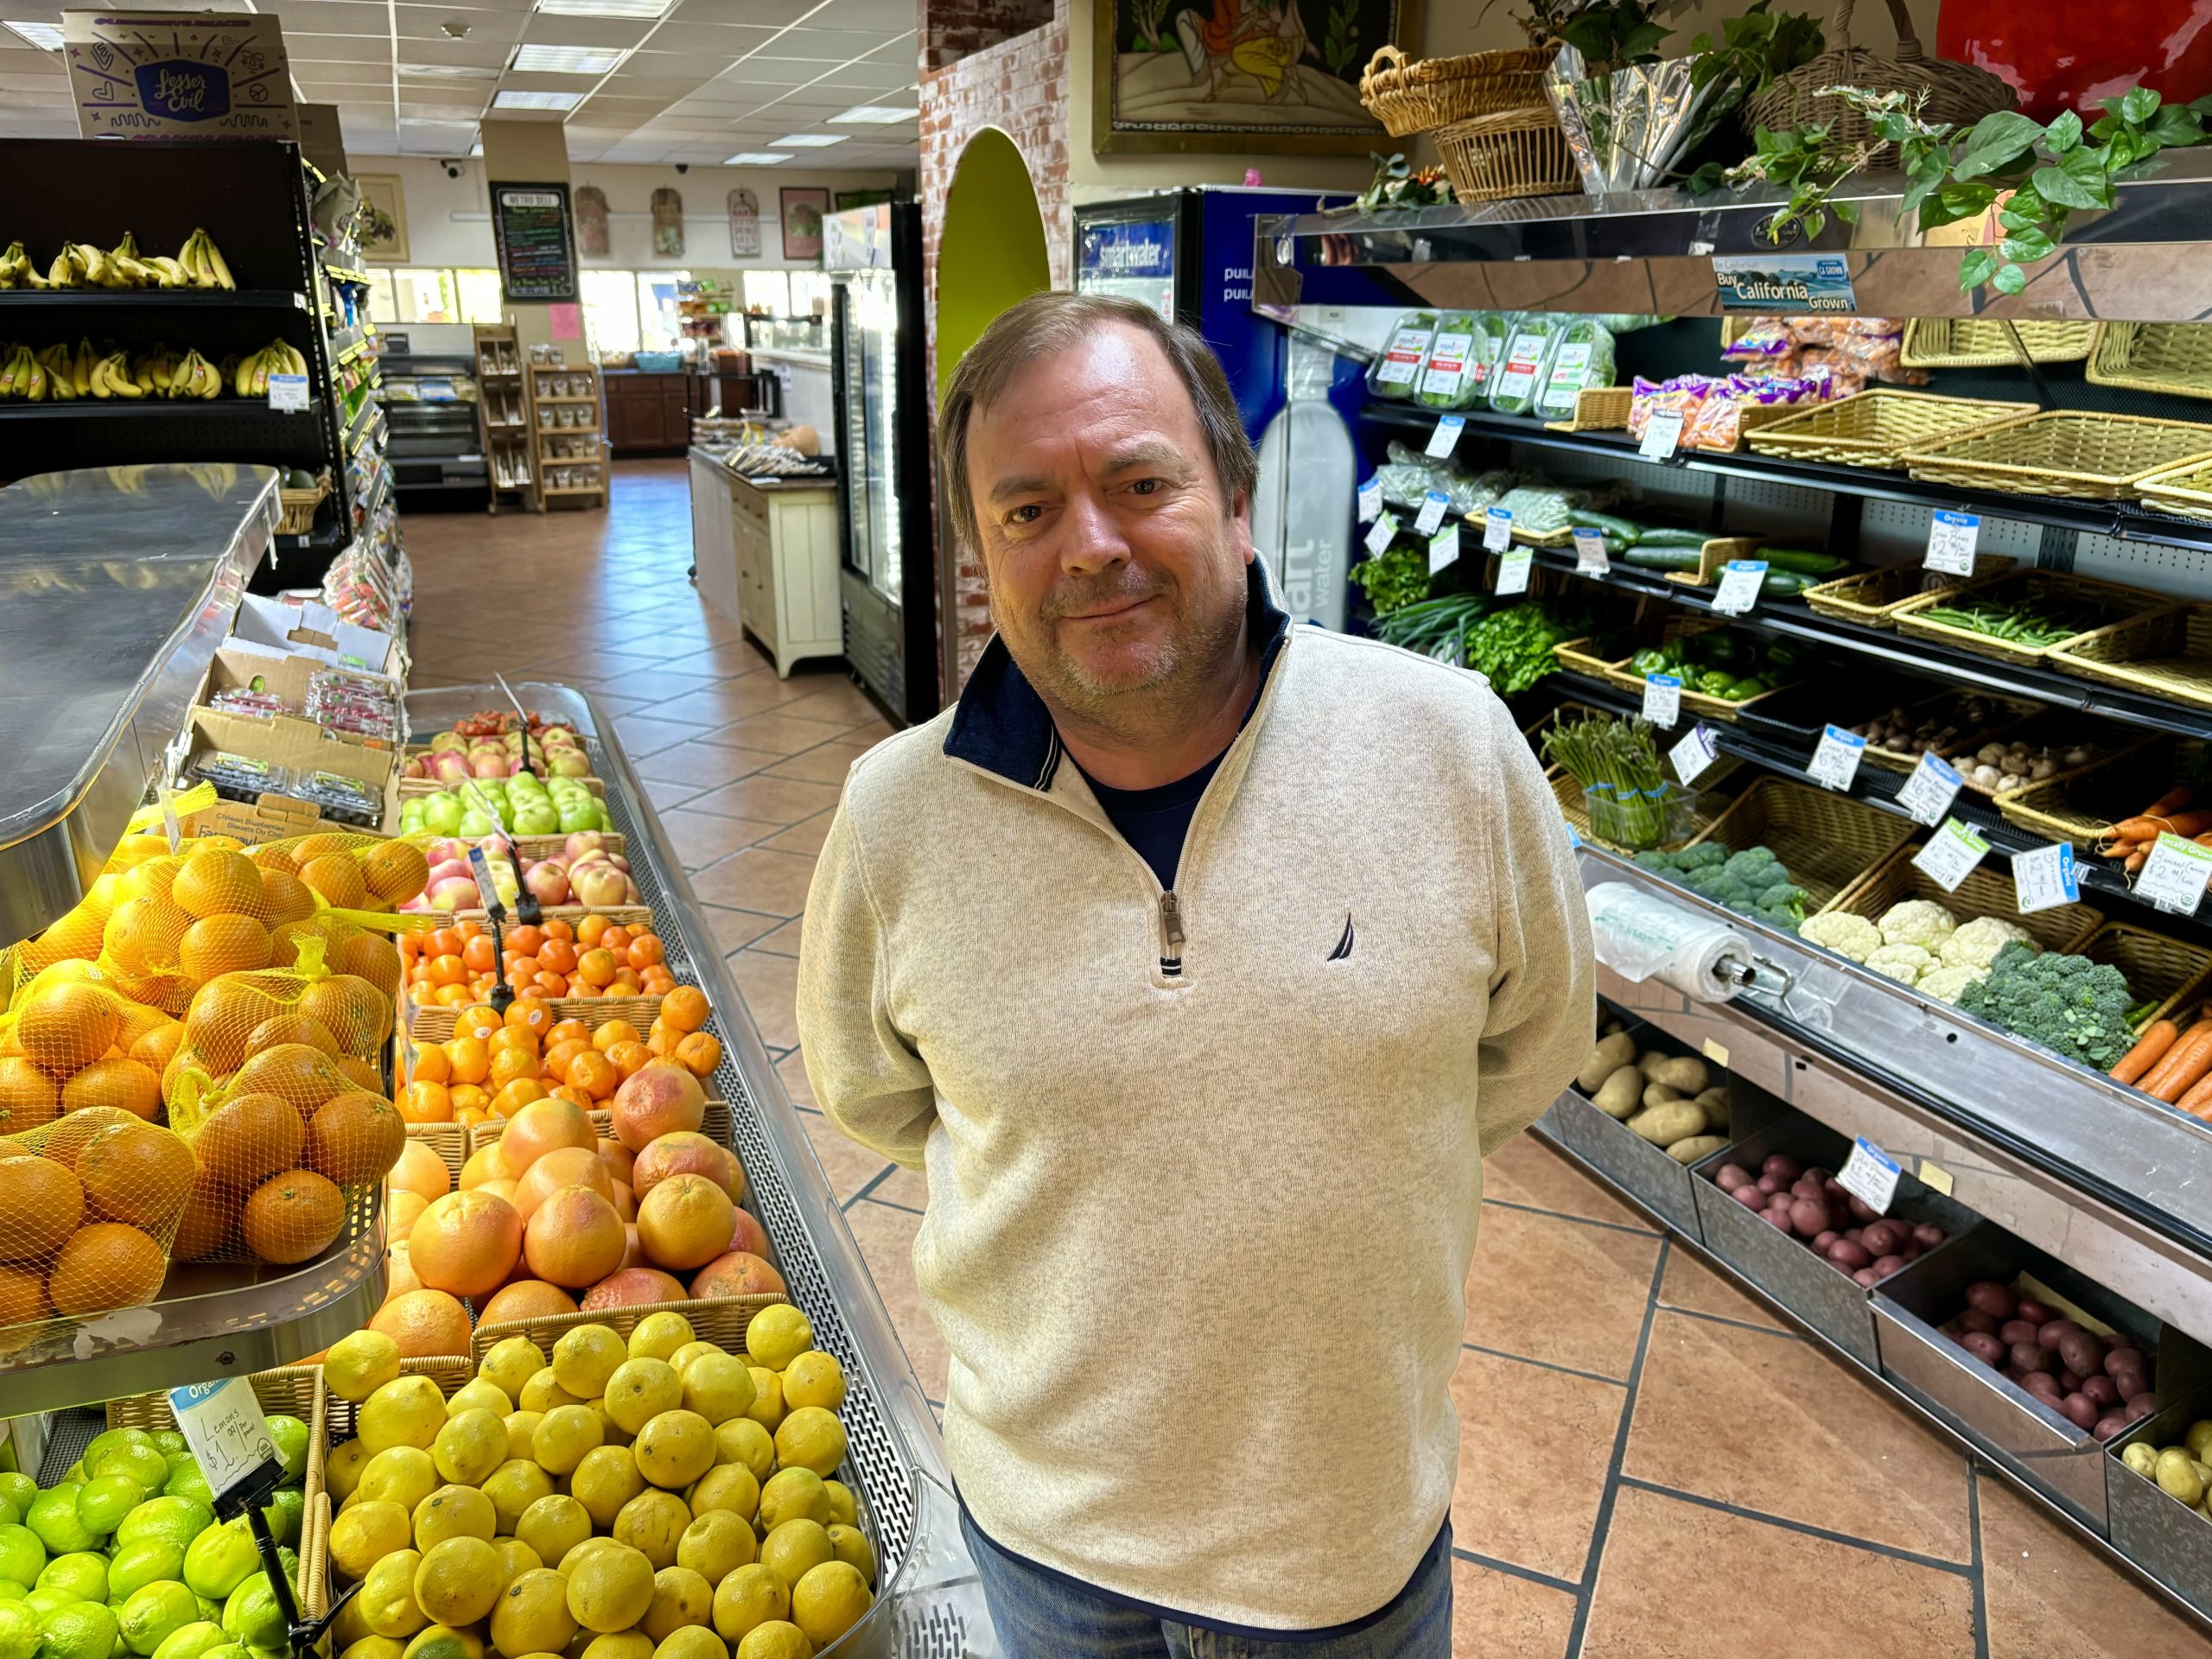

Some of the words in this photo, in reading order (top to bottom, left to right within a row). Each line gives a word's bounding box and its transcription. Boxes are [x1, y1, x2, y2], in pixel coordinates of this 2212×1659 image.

[154, 68, 207, 99] Lesser
[168, 87, 206, 111] Evil
[1099, 238, 1160, 267] smartwater
[1827, 265, 1843, 275] GROWN
[1717, 273, 1737, 289] Buy
[1736, 282, 1809, 300] California
[1808, 296, 1848, 309] Grown
[1944, 514, 1967, 526] Organic
[1313, 539, 1332, 607] water
[2160, 836, 2188, 851] Locally
[2063, 856, 2072, 887] Organic
[200, 1408, 239, 1441] Lemons
